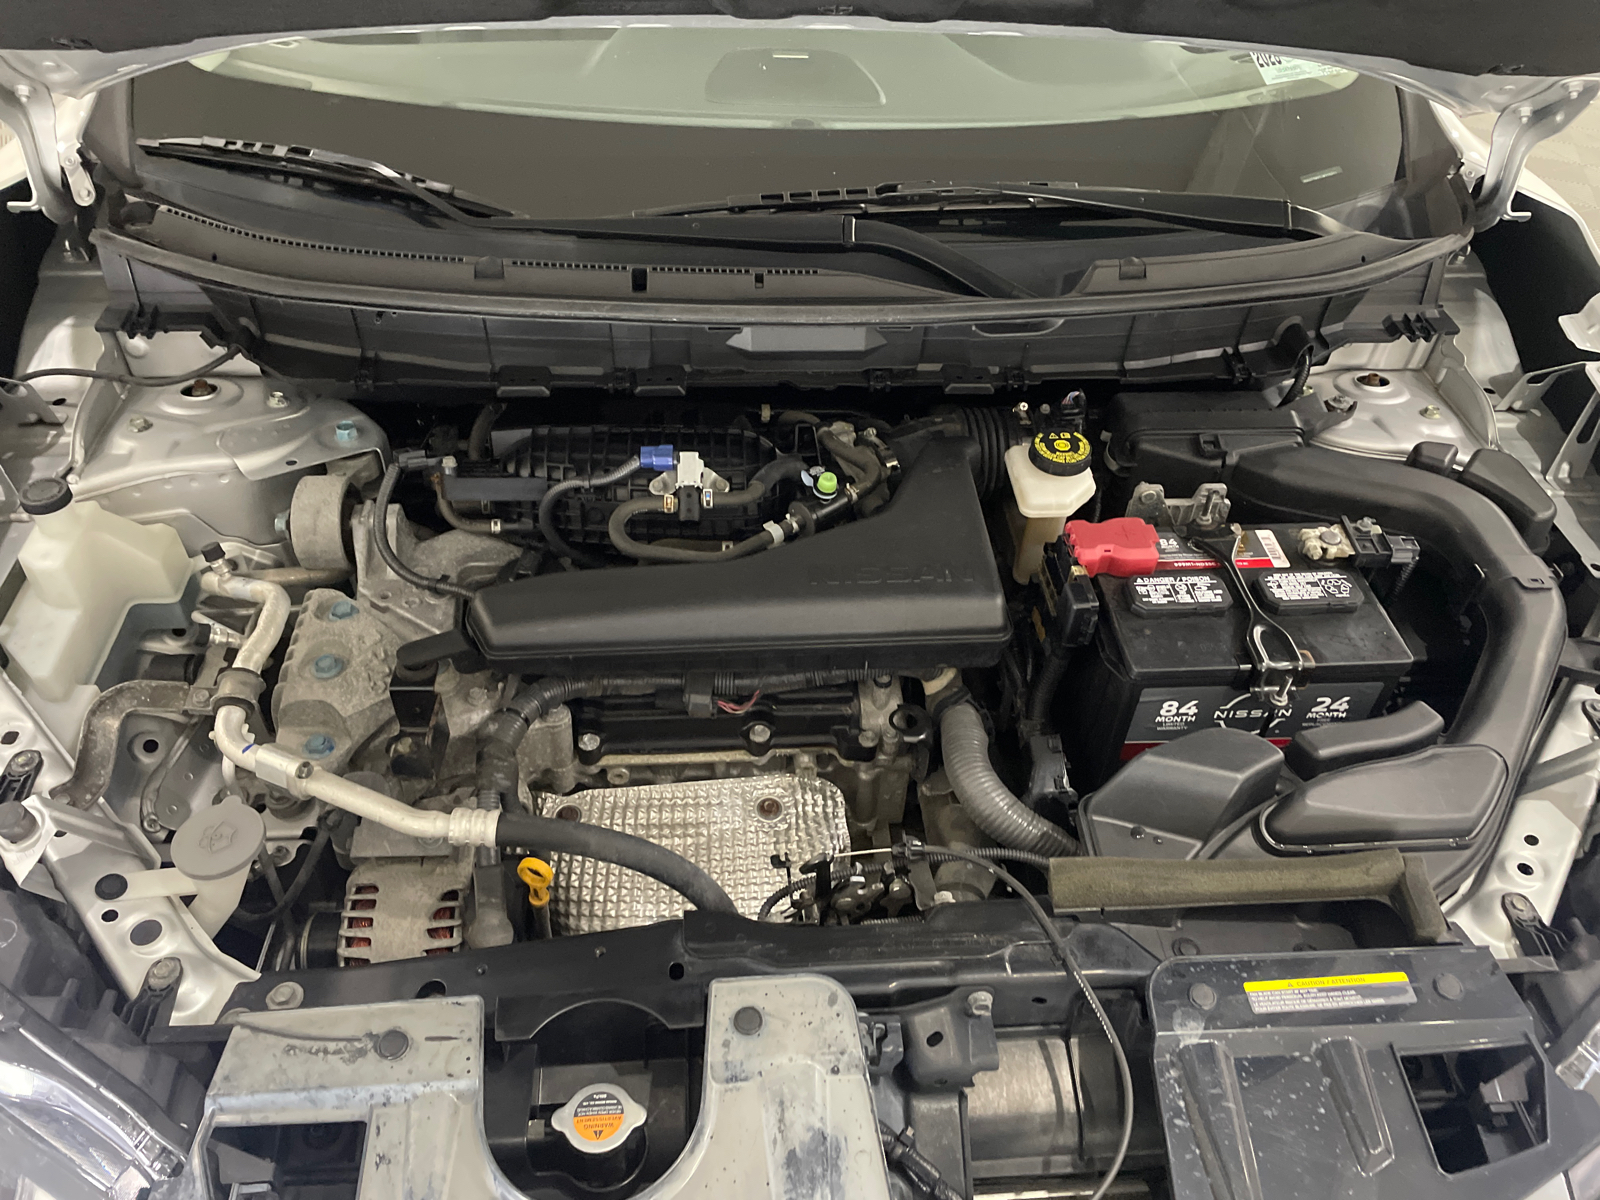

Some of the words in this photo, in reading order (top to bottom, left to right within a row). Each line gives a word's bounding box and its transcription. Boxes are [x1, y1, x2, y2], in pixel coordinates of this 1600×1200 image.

[1181, 575, 1211, 583] POISON
[1160, 700, 1199, 716] 84
[1311, 696, 1351, 712] 24
[1155, 715, 1196, 723] MONTH
[1306, 711, 1347, 719] MONTH
[1331, 977, 1366, 985] ATTENTION
[583, 1122, 614, 1130] WARNING
